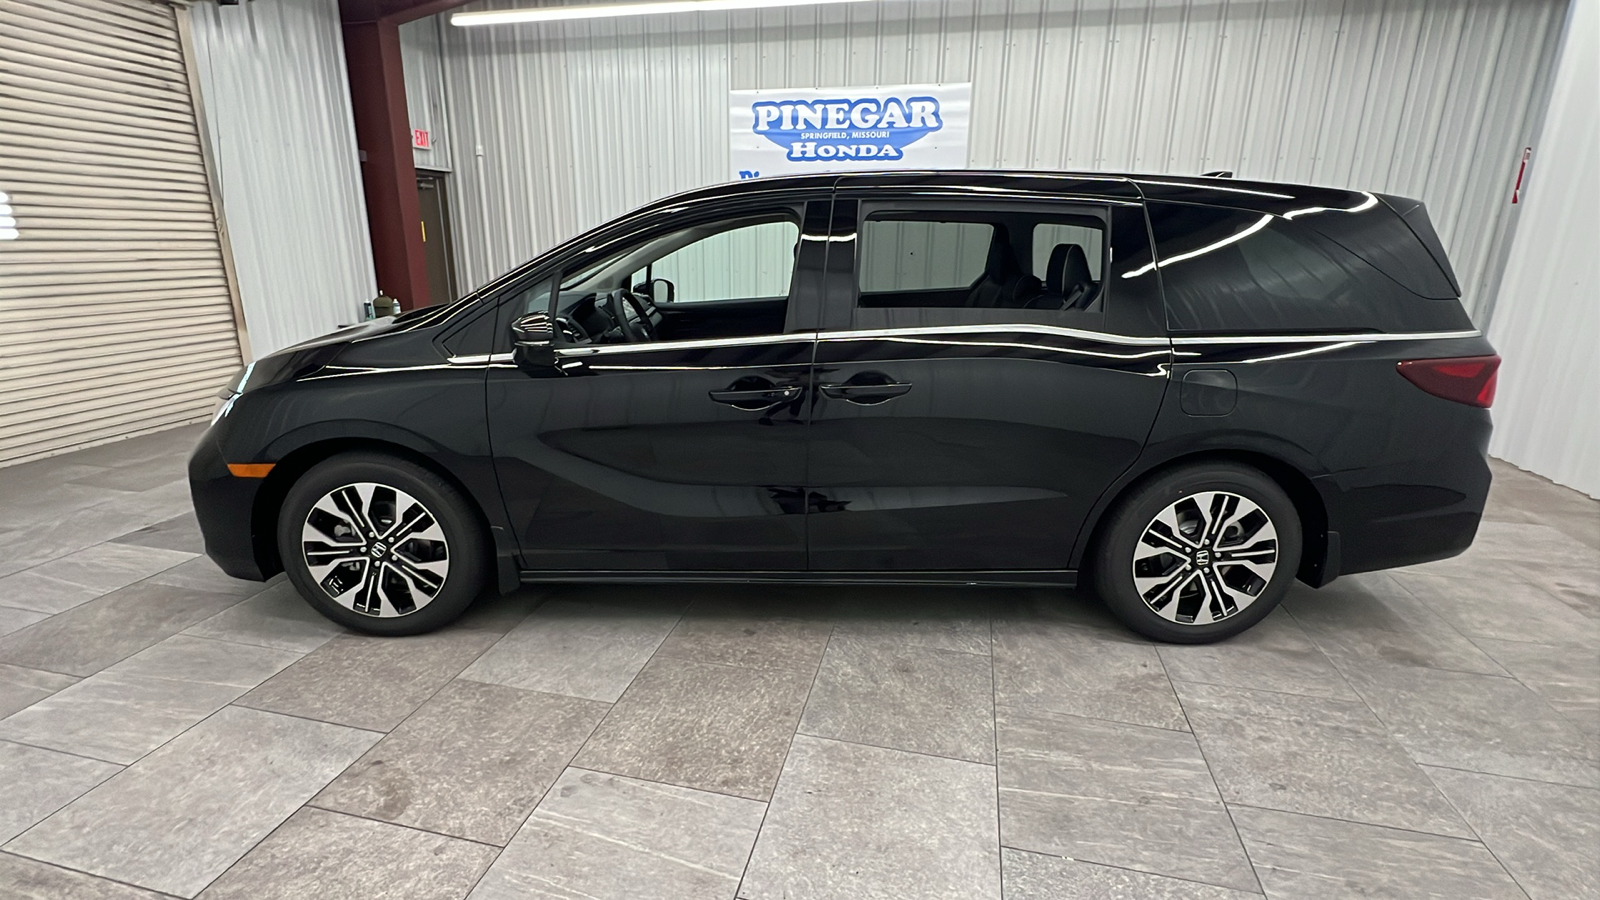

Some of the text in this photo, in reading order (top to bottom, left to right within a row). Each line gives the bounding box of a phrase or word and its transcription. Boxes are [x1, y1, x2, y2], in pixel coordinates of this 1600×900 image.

[754, 100, 940, 131] PINEGAR
[414, 129, 429, 147] EXIT
[800, 132, 850, 140] SPRINGFIELD,
